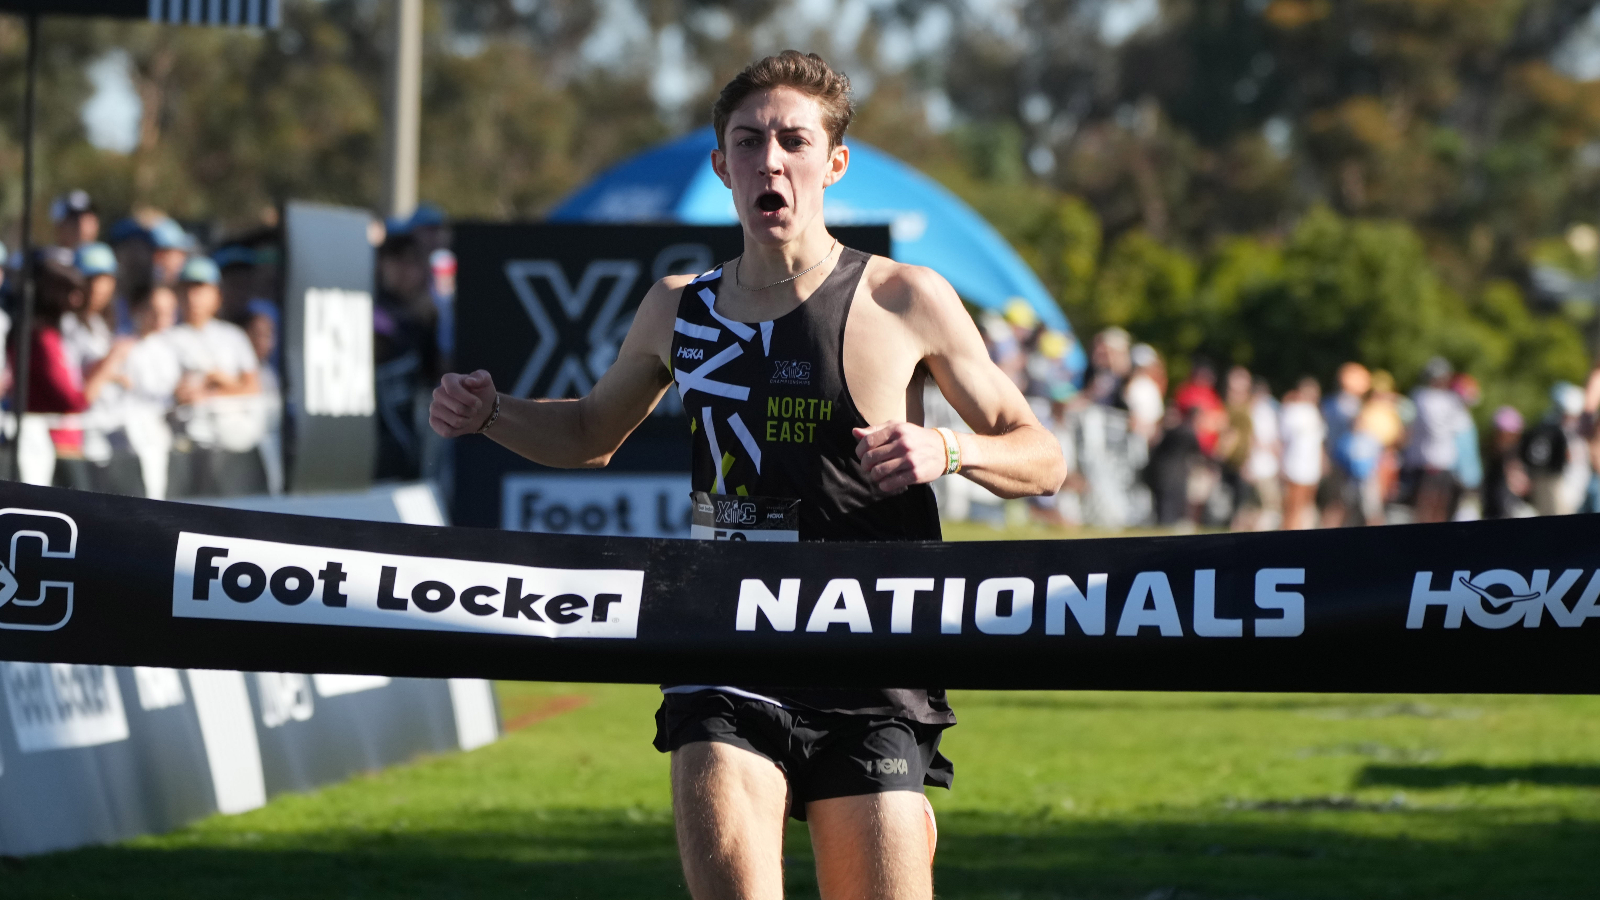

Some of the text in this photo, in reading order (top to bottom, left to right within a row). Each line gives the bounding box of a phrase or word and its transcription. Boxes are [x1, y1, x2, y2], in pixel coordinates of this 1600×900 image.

[676, 346, 704, 360] HOKA
[767, 396, 832, 421] NORTH
[766, 421, 817, 443] EAST
[520, 490, 634, 533] Foot
[192, 546, 623, 625] Foot Locker
[1405, 568, 1600, 630] HOKA
[735, 568, 1306, 638] NATIONALS
[866, 758, 909, 776] HOKA
